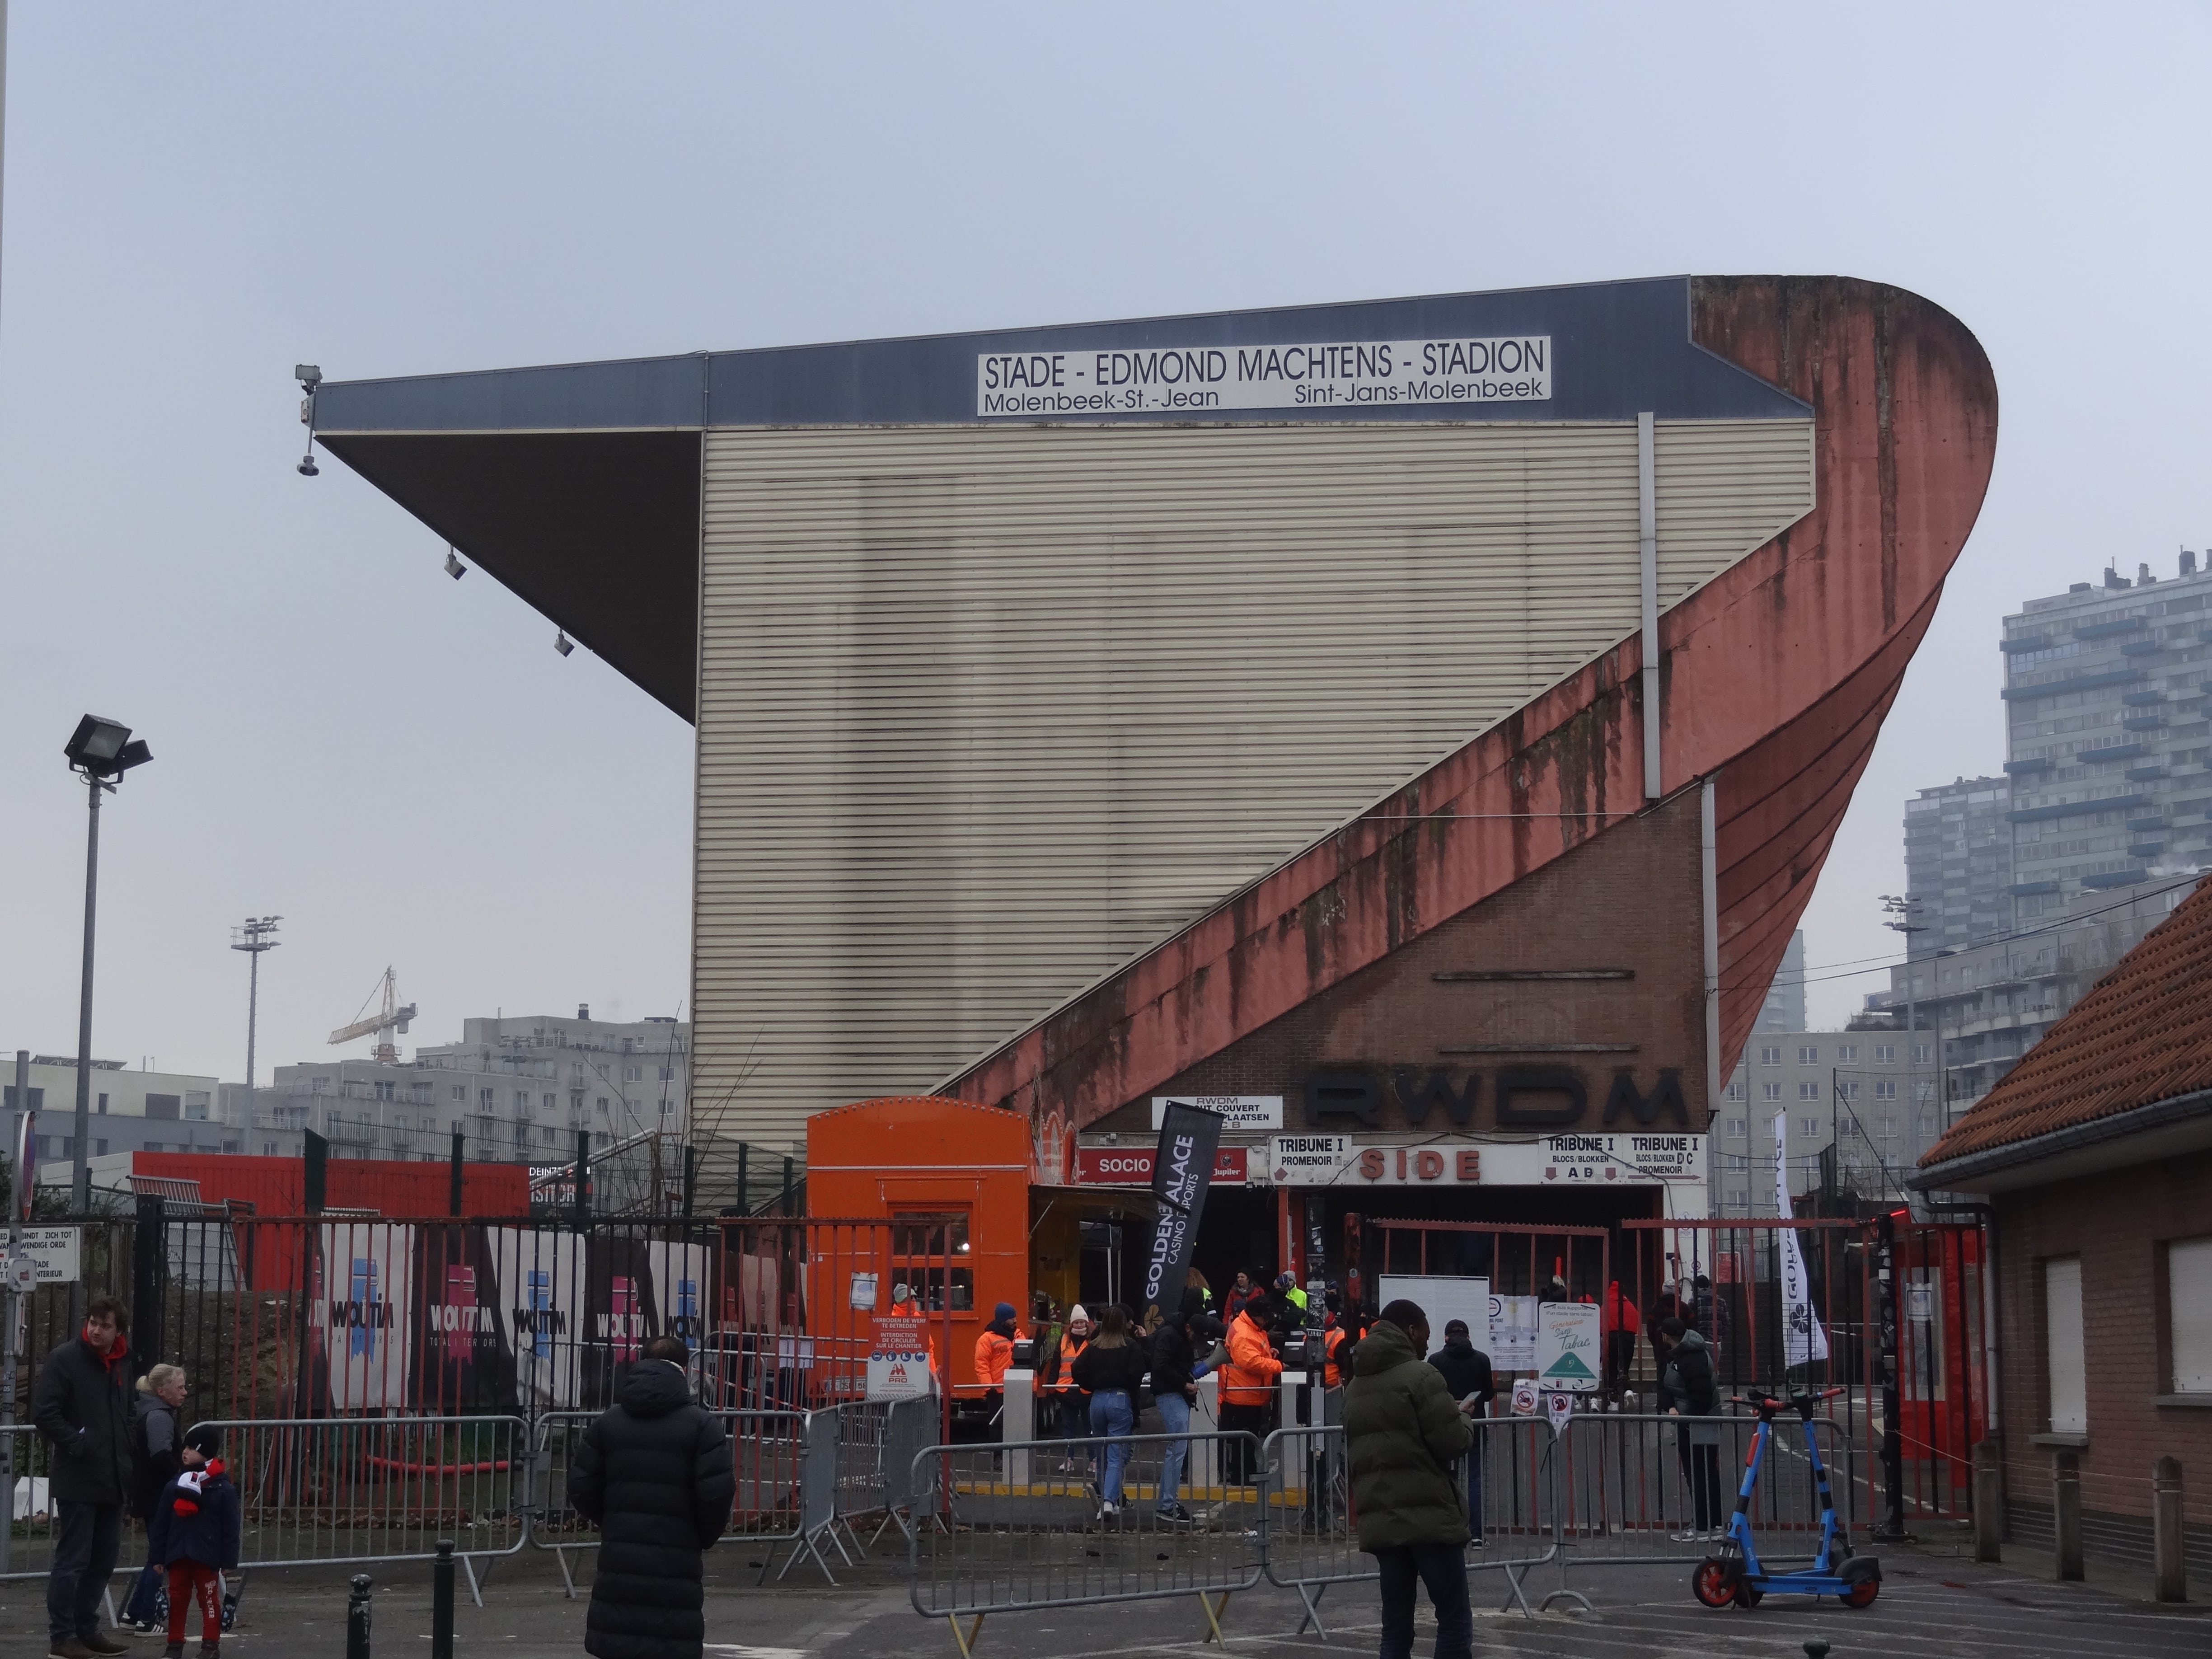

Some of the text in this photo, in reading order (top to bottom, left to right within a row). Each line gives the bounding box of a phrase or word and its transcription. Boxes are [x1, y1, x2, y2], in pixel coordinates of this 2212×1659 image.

[985, 355, 1064, 389] STADE
[1097, 351, 1227, 385] EDMOND
[1238, 345, 1392, 381] MACHTENS
[1423, 340, 1543, 375] STADION
[1295, 378, 1543, 403] Sint-Jans-Molenbeek
[984, 389, 1219, 412] Molenbeek-St.-Jean
[1304, 1071, 1691, 1128] RWDM
[1278, 1138, 1343, 1152] TRIBUNE I
[1547, 1137, 1614, 1151] TRIBUNE I
[1631, 1137, 1698, 1151] TRIBUNE I
[1099, 1158, 1150, 1172] SOCIO
[1281, 1156, 1332, 1166] PROMENOIR
[1359, 1149, 1480, 1180] SIDE
[1687, 1153, 1693, 1165] C
[1213, 1168, 1241, 1176] Jupiler
[1568, 1167, 1578, 1178] A
[1639, 1166, 1682, 1174] PROMENOIR
[1167, 1220, 1186, 1265] CASINO
[1559, 1334, 1590, 1350] Tabac
